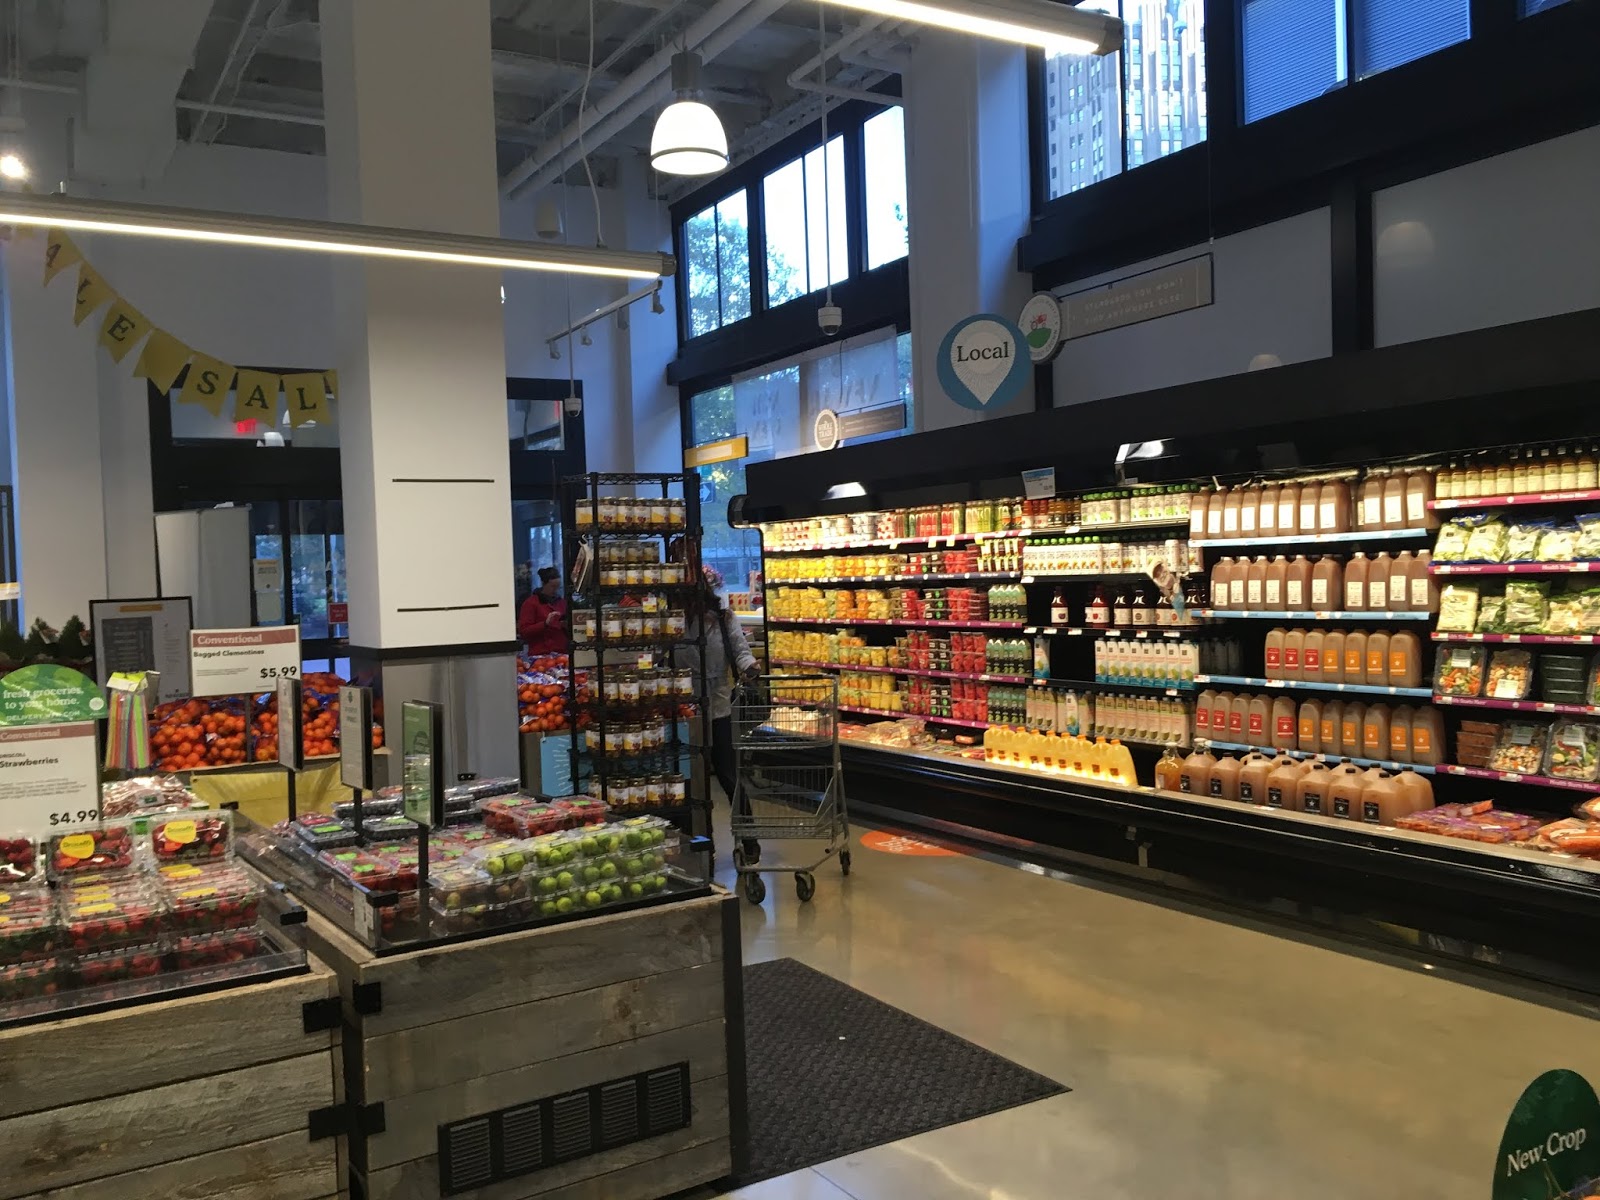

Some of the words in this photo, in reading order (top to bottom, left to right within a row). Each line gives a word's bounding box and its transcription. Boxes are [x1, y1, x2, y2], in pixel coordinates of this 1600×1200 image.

[957, 342, 1009, 363] Local
[197, 634, 262, 645] Conventional
[222, 649, 264, 657] Clementines
[260, 666, 297, 678] $5.99
[3, 689, 30, 699] fresh
[0, 729, 60, 740] Conventional
[0, 757, 59, 768] Strawberries
[49, 809, 98, 826] $4.99
[1507, 1145, 1544, 1177] New
[1547, 1128, 1587, 1157] Crop
